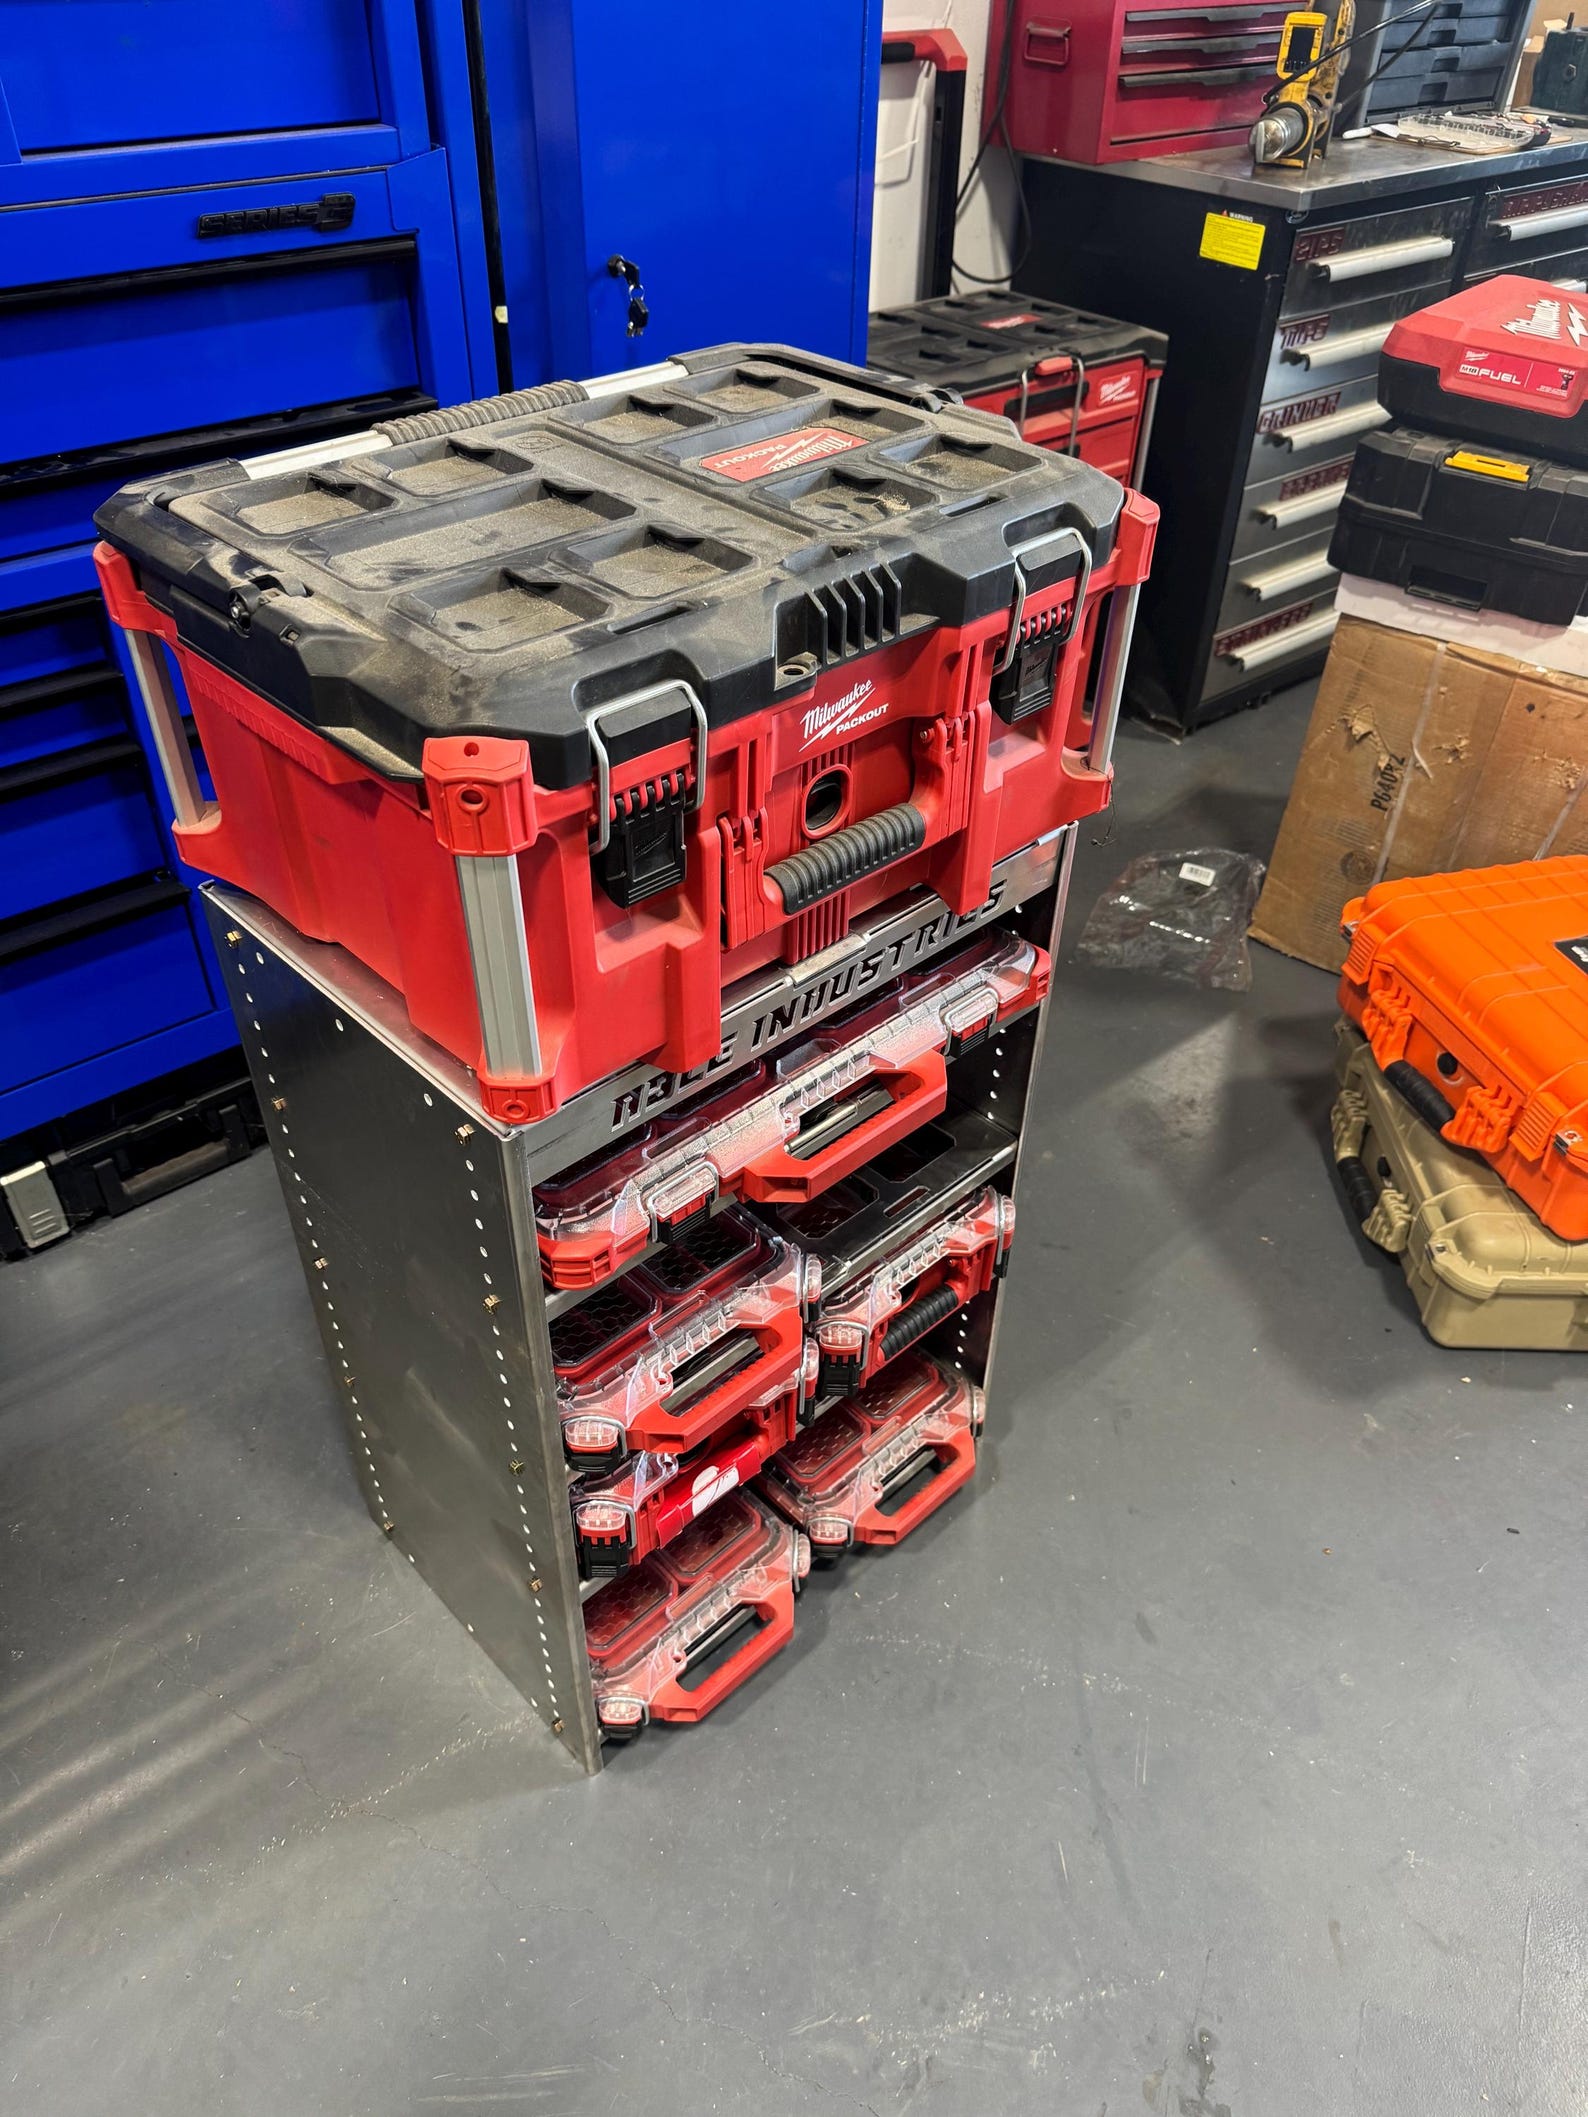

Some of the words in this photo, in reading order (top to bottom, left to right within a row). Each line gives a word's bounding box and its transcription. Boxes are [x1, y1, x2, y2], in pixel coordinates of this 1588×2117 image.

[199, 203, 321, 239] SERIES
[1479, 368, 1521, 385] FUEL
[714, 444, 787, 469] PACKOUT
[768, 434, 852, 472] Milwaukee
[800, 680, 872, 739] Milwaukee
[836, 703, 889, 735] PACKOUT
[750, 879, 1007, 1052] INDUSTRIES
